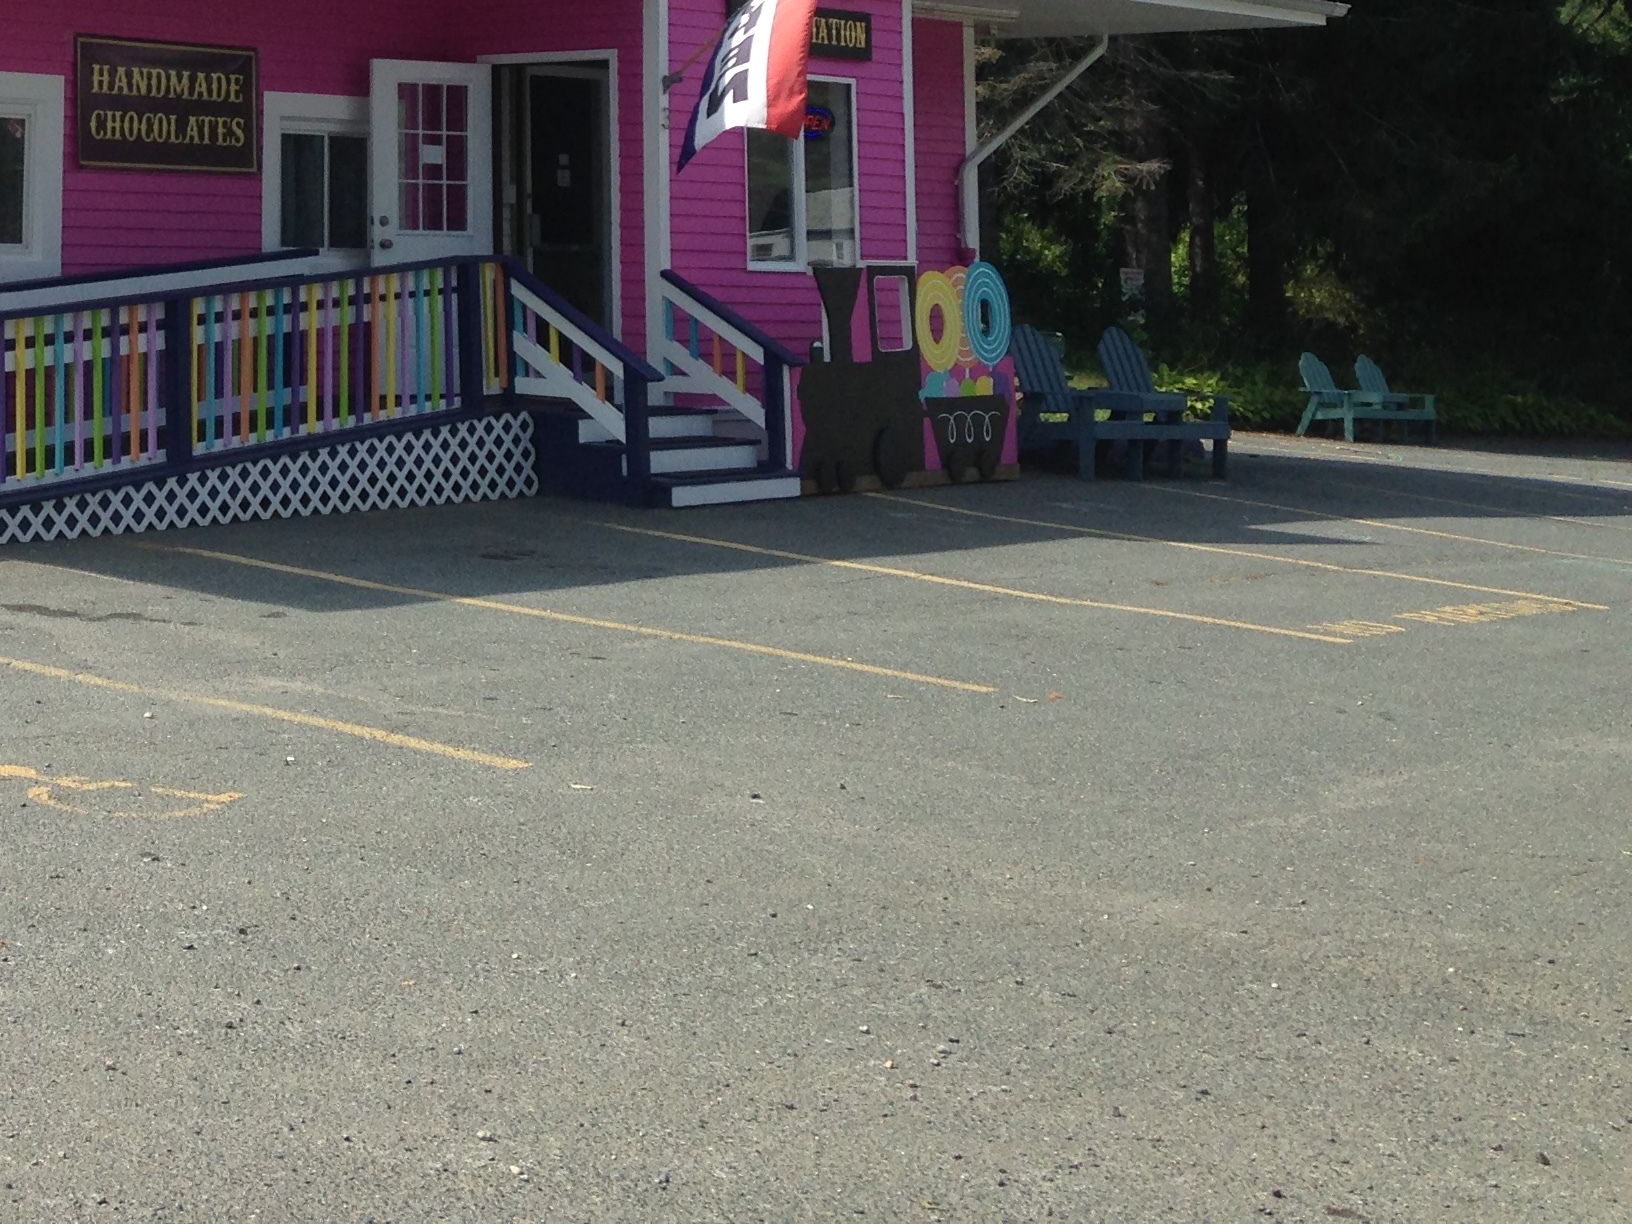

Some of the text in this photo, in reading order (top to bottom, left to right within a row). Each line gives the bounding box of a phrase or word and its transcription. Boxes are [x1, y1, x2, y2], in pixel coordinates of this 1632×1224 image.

[812, 16, 867, 48] TATION
[91, 63, 244, 103] HANDMADE
[89, 109, 245, 147] CHOCOLATES
